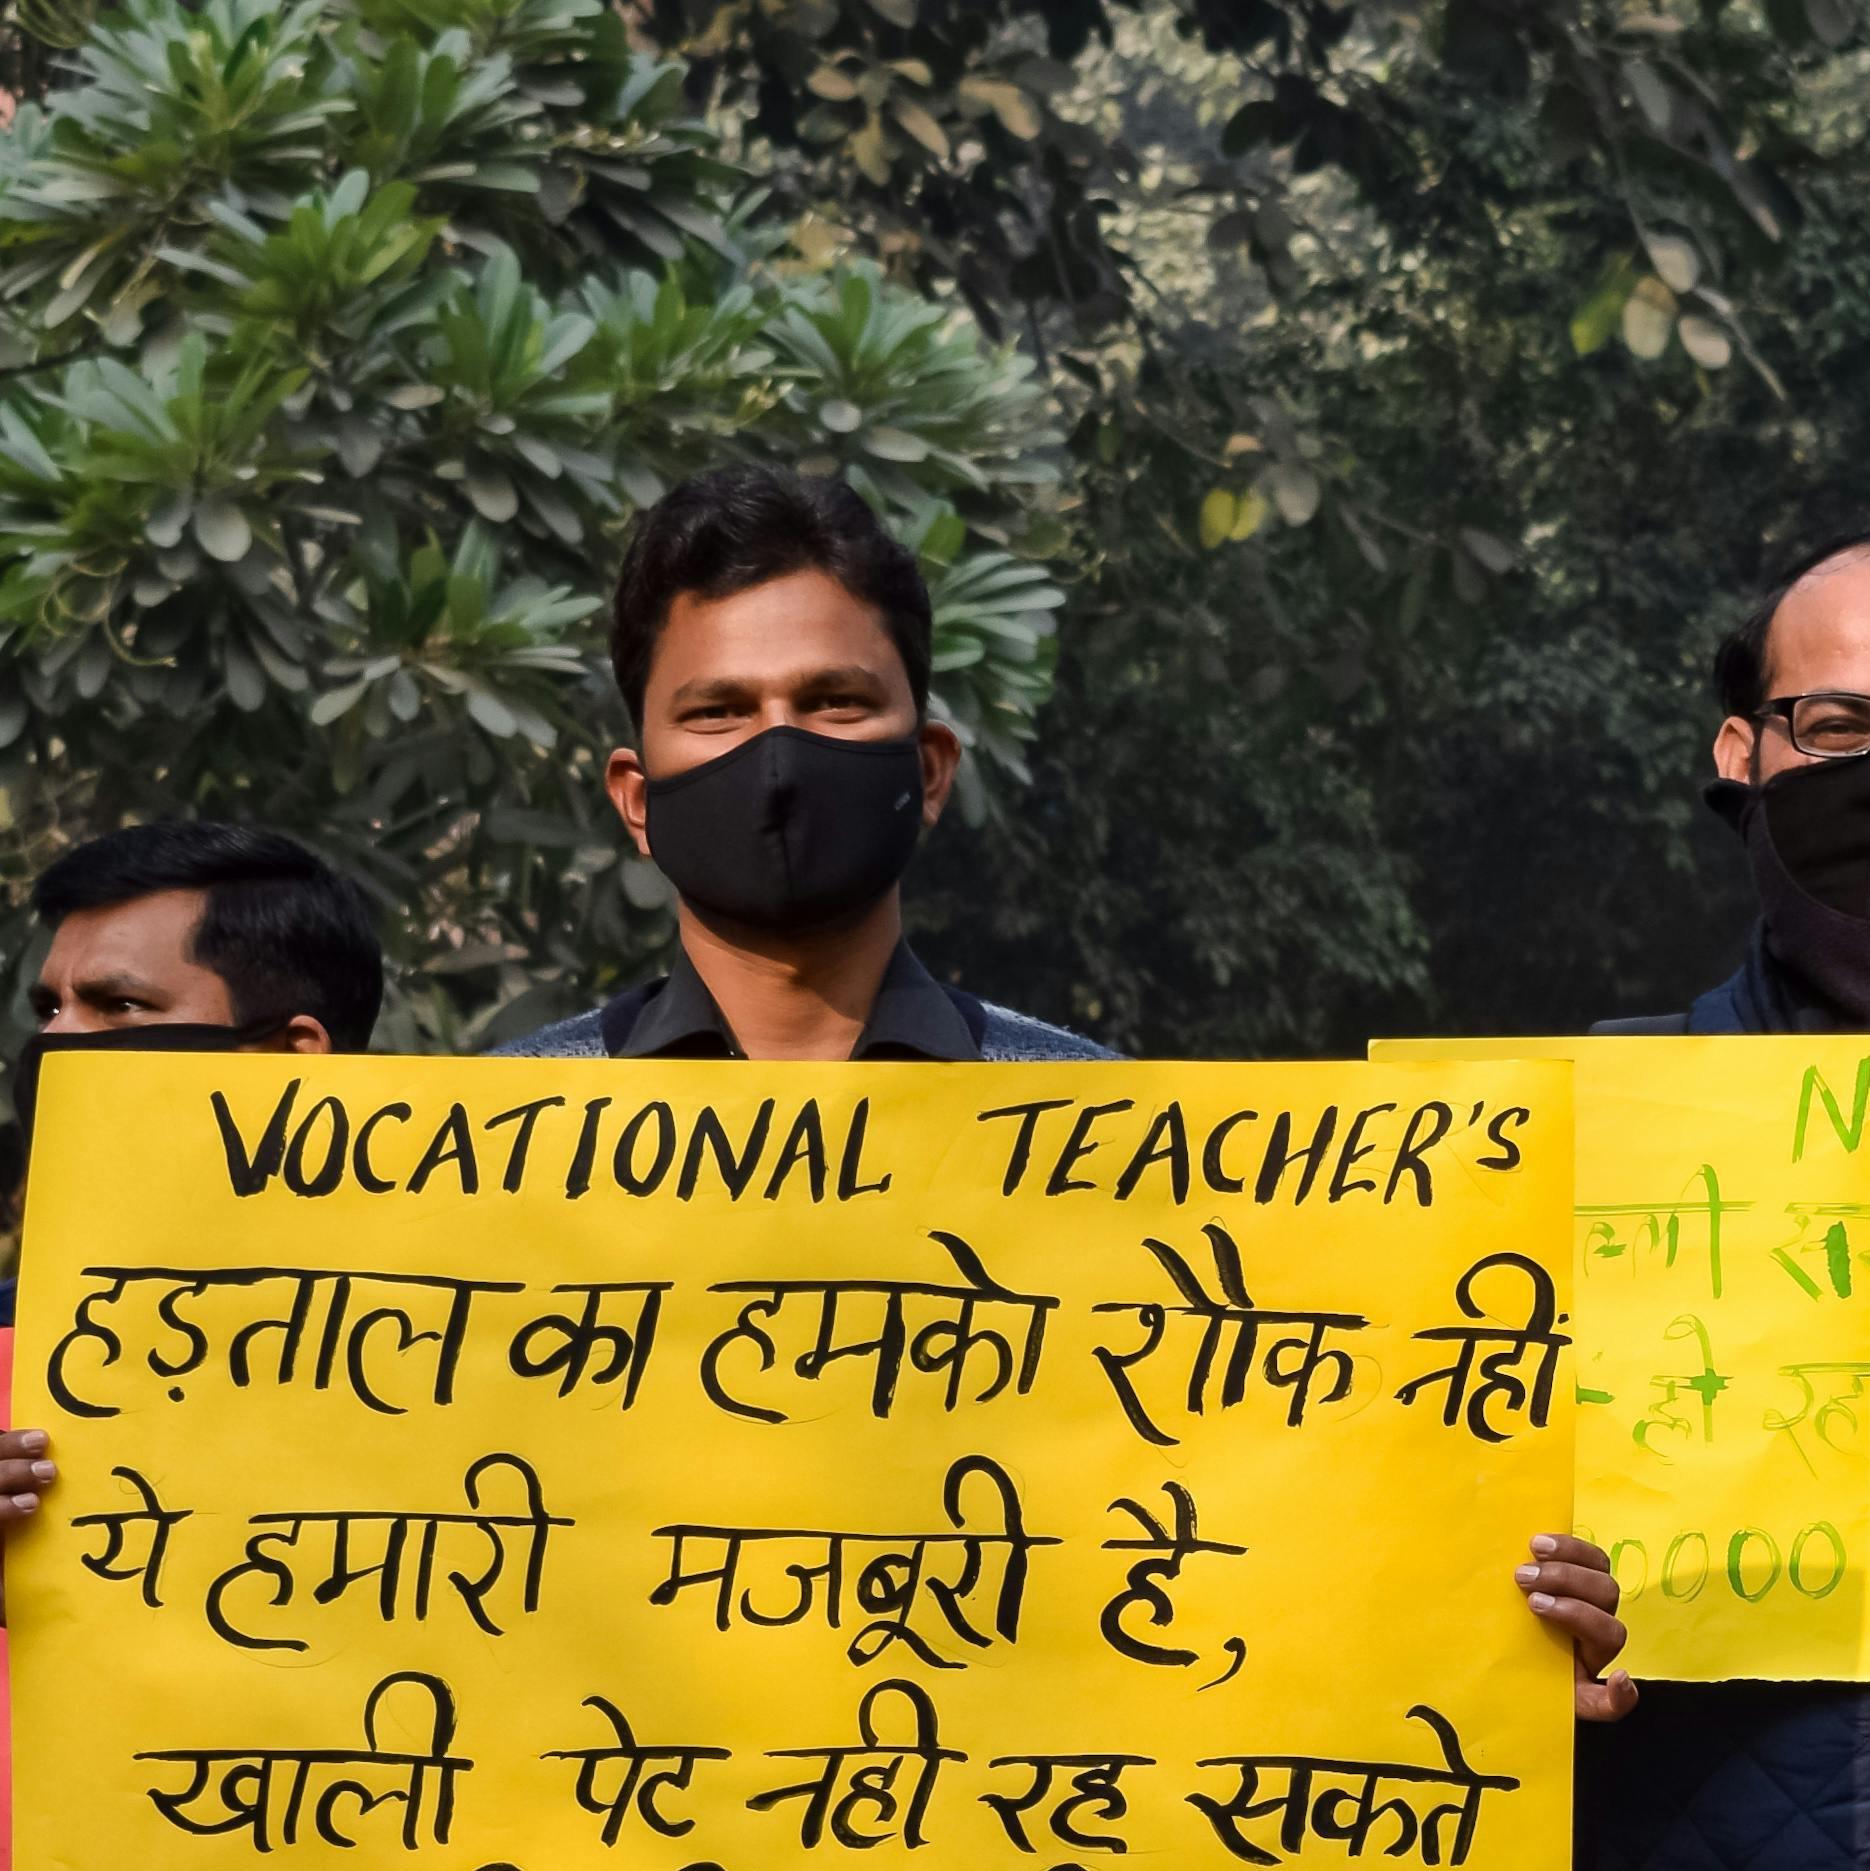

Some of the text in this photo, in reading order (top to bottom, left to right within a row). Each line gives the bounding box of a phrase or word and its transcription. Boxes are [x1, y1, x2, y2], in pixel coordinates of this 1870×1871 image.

[211, 1079, 891, 1202] VOCATIONAL
[48, 1225, 1572, 1446] हड़ताल का हमको शौक नहीं
[72, 1453, 1247, 1692] ये हमारी मजबूरी है,
[1573, 1521, 1847, 1603] 0000
[134, 1671, 474, 1853] खाली
[540, 1695, 732, 1847] पेट
[978, 1754, 1157, 1854] रह
[1185, 1705, 1521, 1867] सकते
